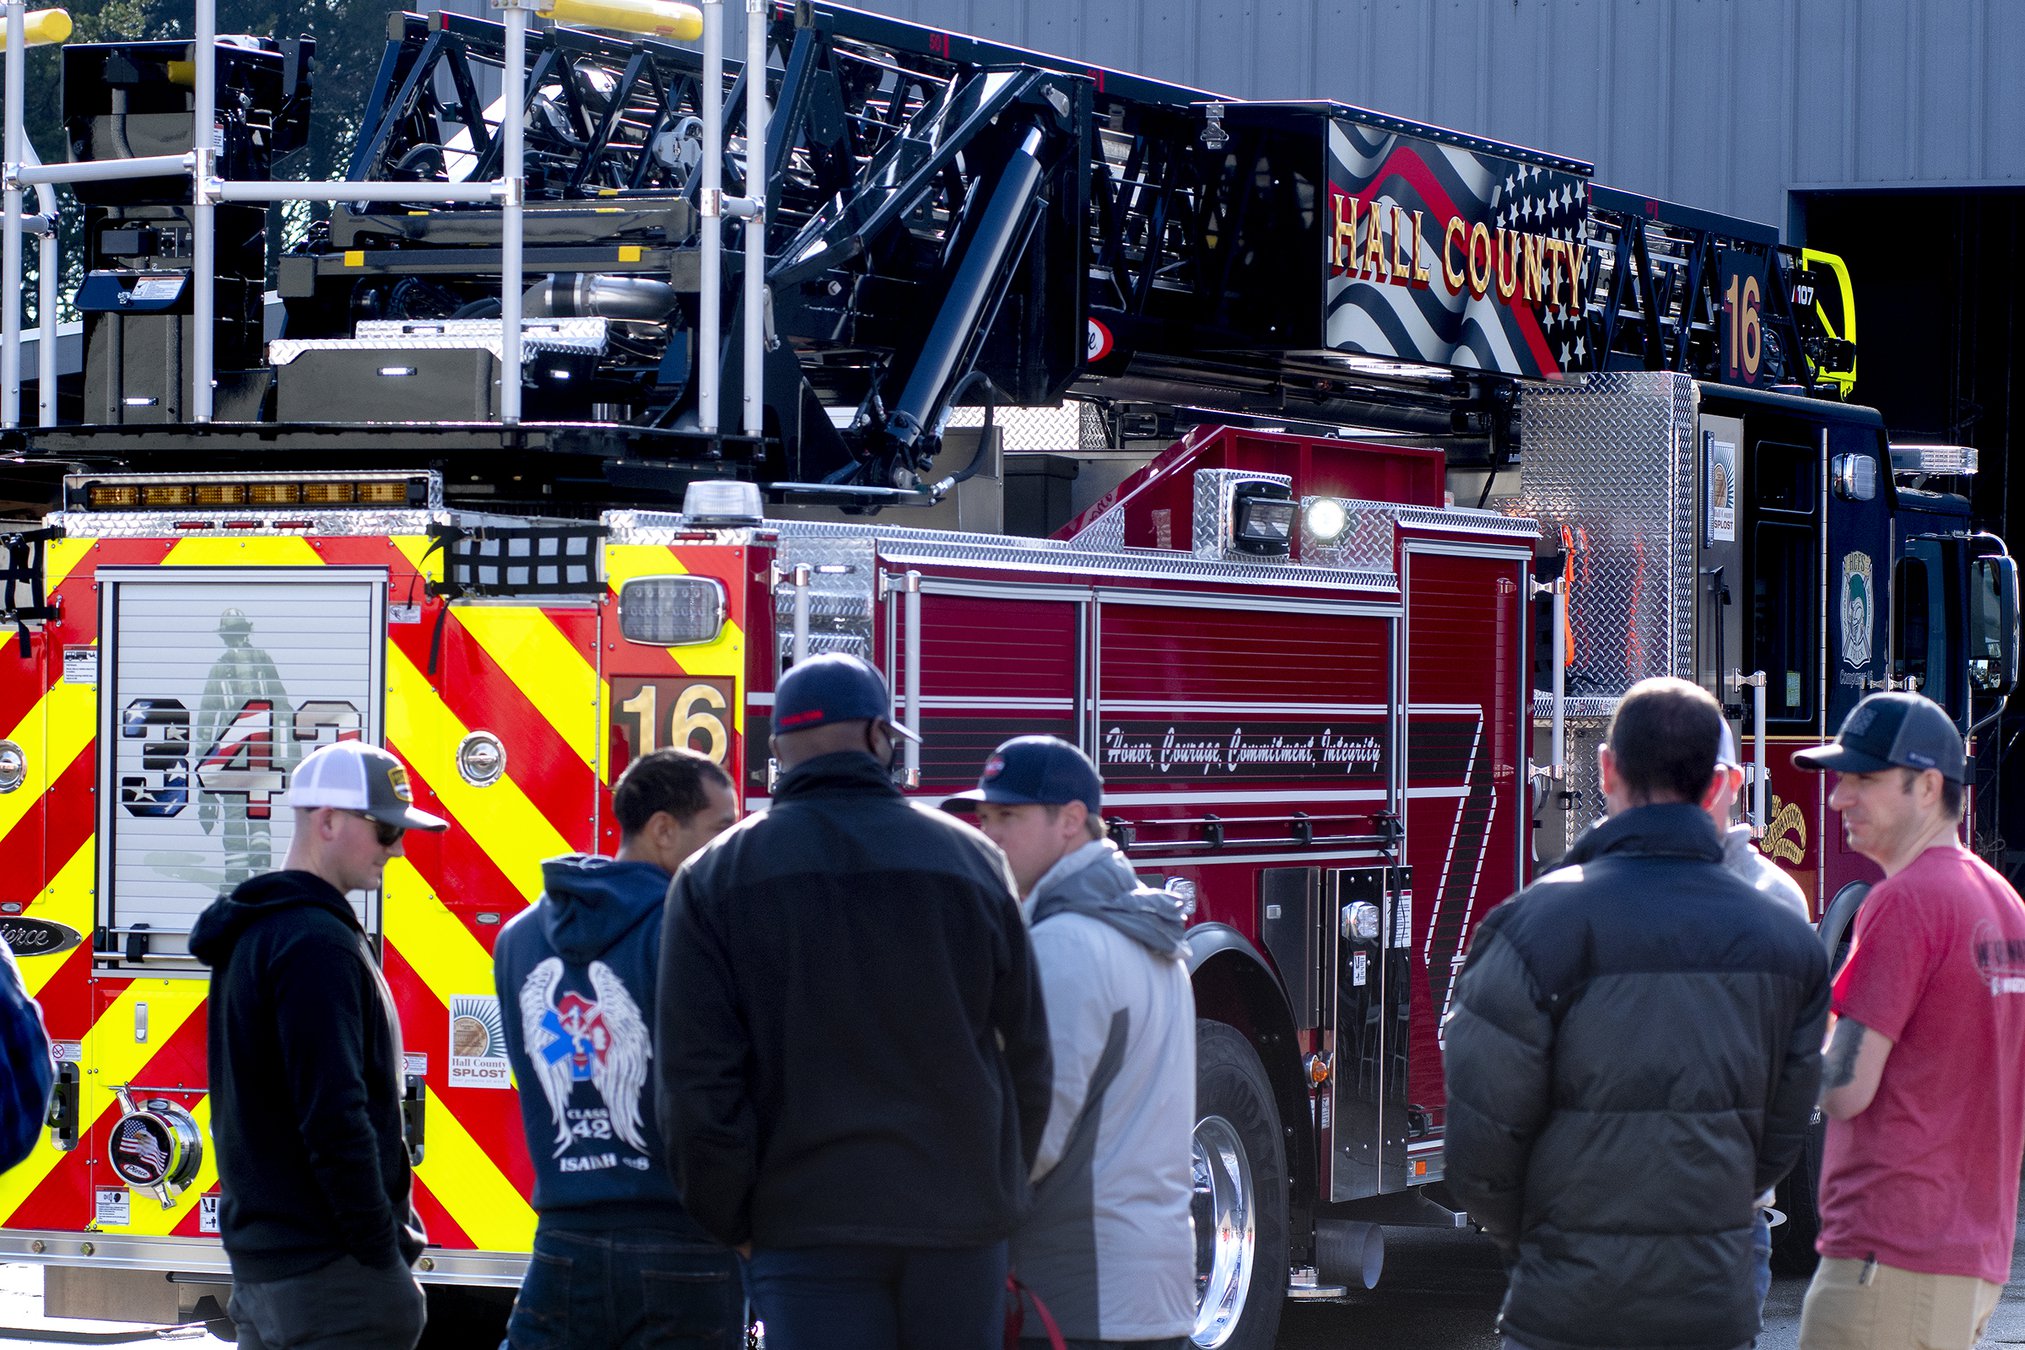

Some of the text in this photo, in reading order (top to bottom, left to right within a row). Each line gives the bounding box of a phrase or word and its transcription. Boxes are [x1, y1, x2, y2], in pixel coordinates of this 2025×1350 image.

[1333, 194, 1586, 311] HALL COUNTY
[1725, 274, 1761, 377] 16
[622, 684, 728, 766] 16
[1106, 727, 1382, 775] Honor, Courage, Commitment, Integrity
[452, 1058, 506, 1069] Hall County
[452, 1068, 506, 1078] SPLOST
[567, 1108, 609, 1120] CLASS
[572, 1119, 612, 1140] 42
[125, 1164, 148, 1178] Pierce
